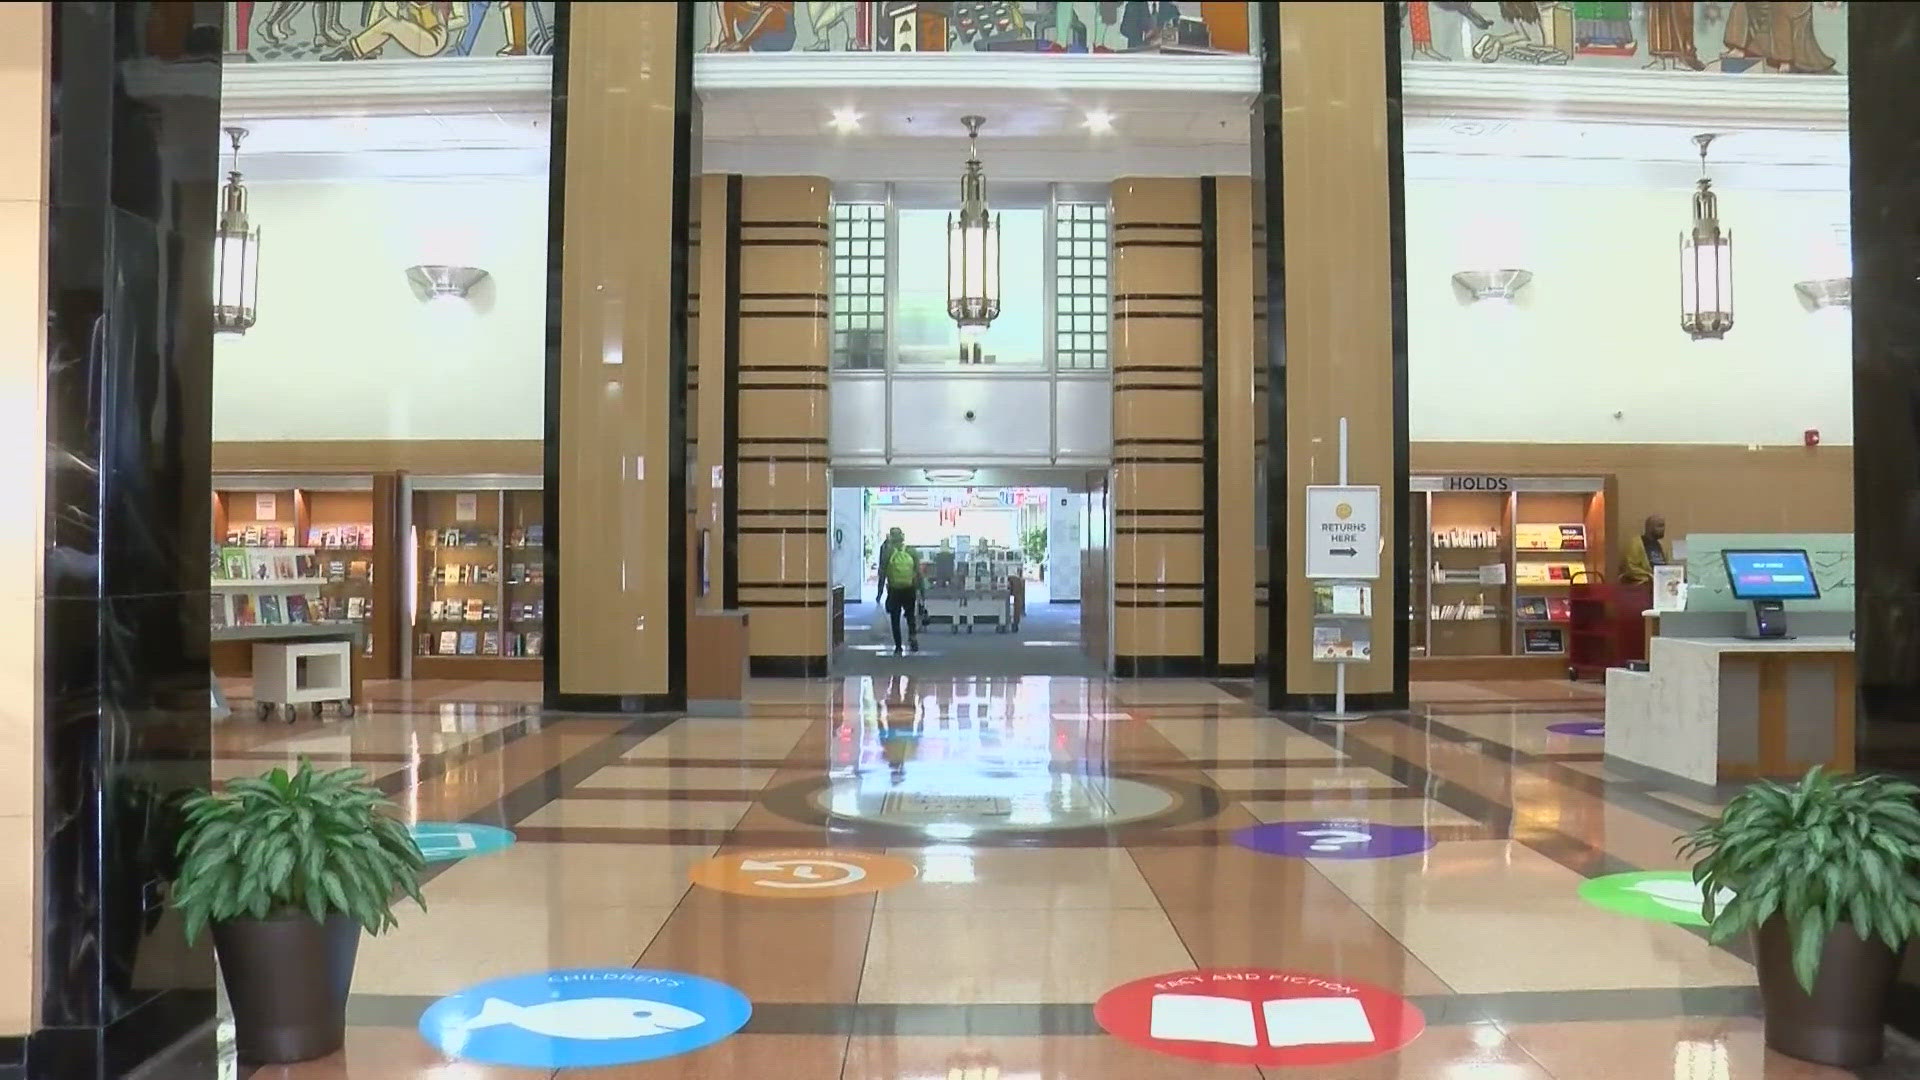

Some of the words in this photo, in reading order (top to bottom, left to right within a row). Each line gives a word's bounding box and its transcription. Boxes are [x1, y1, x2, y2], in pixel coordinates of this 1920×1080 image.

[1450, 477, 1508, 490] HOLDS
[1321, 523, 1367, 532] RETURNS
[1331, 534, 1357, 542] HERE
[1212, 973, 1261, 982] AND
[1268, 974, 1359, 994] FICTION
